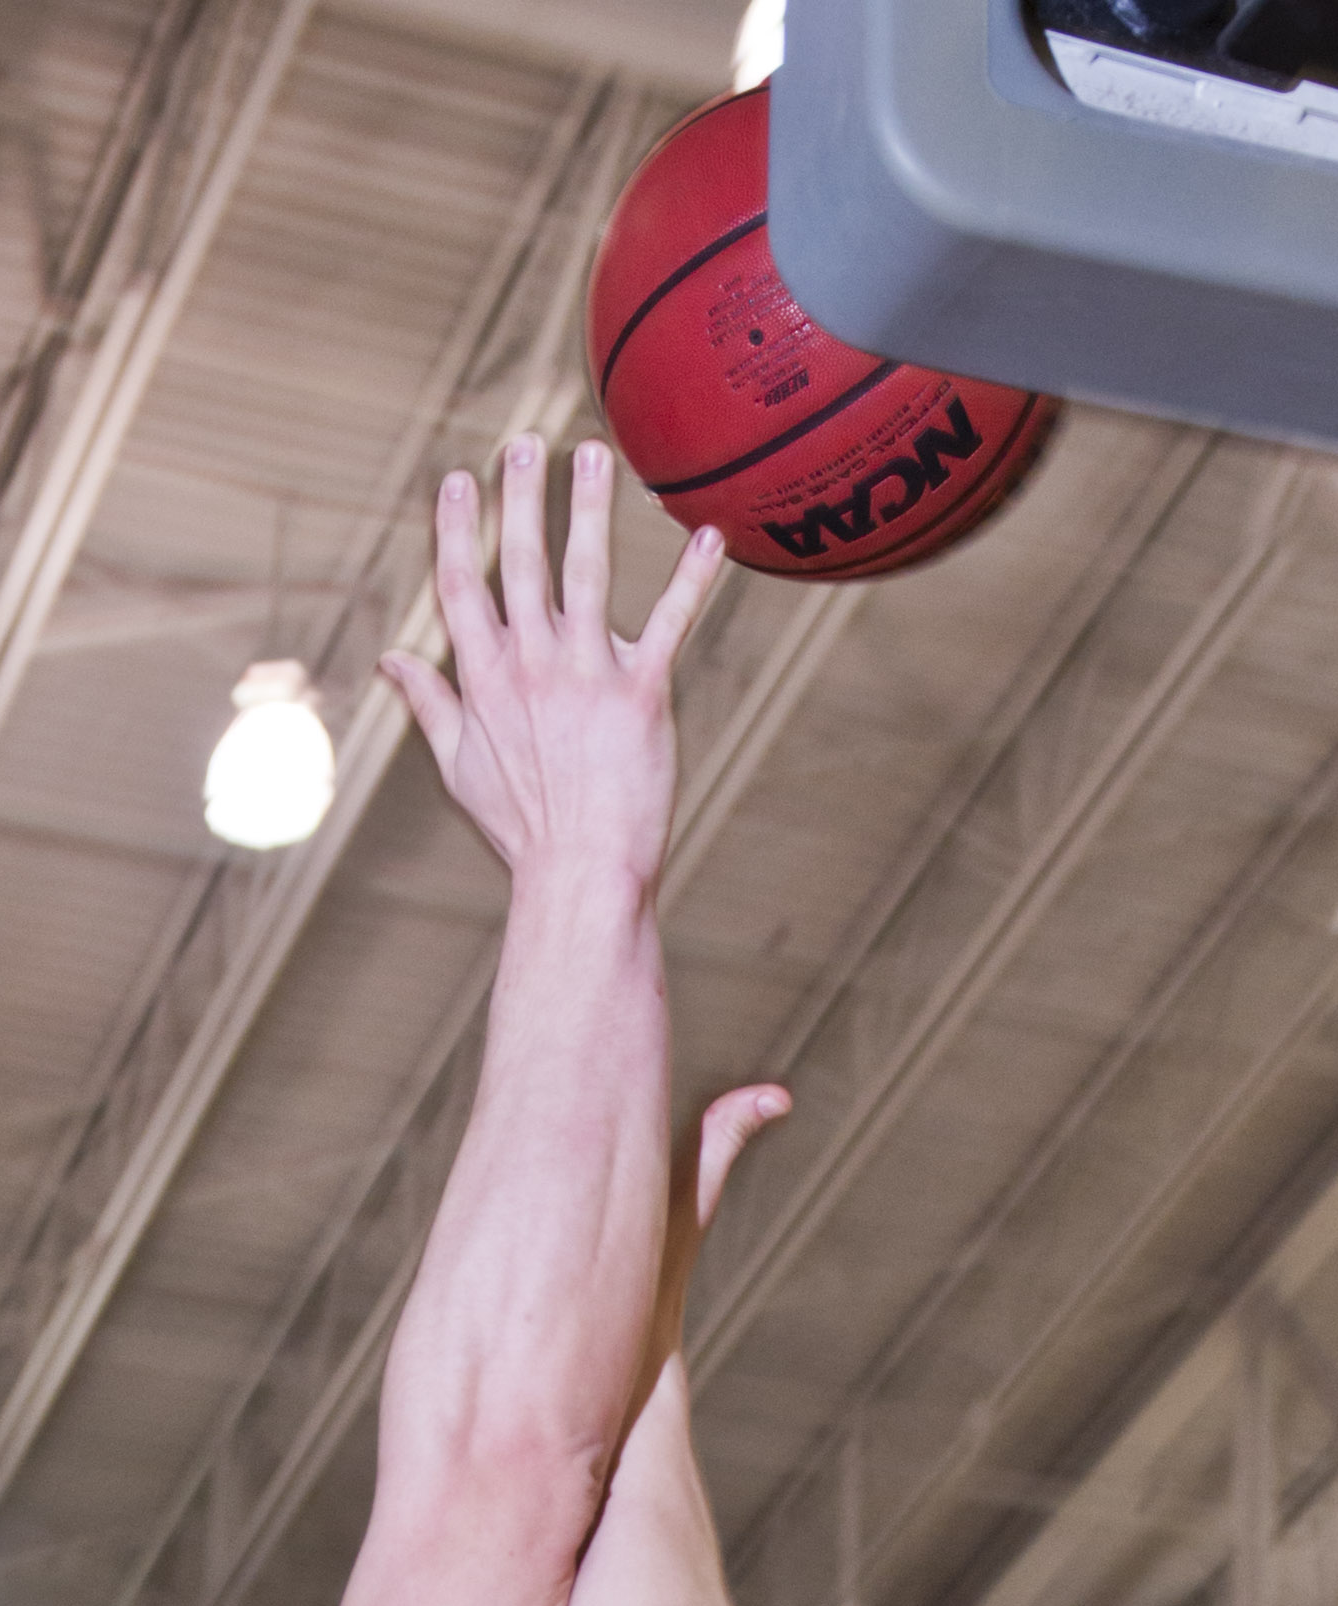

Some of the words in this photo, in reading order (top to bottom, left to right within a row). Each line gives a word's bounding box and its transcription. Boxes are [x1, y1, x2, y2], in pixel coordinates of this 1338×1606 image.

[868, 379, 951, 457] OFFICIAL
[749, 492, 804, 514] BALL
[761, 397, 984, 560] NCAA
[806, 456, 867, 497] GAME
